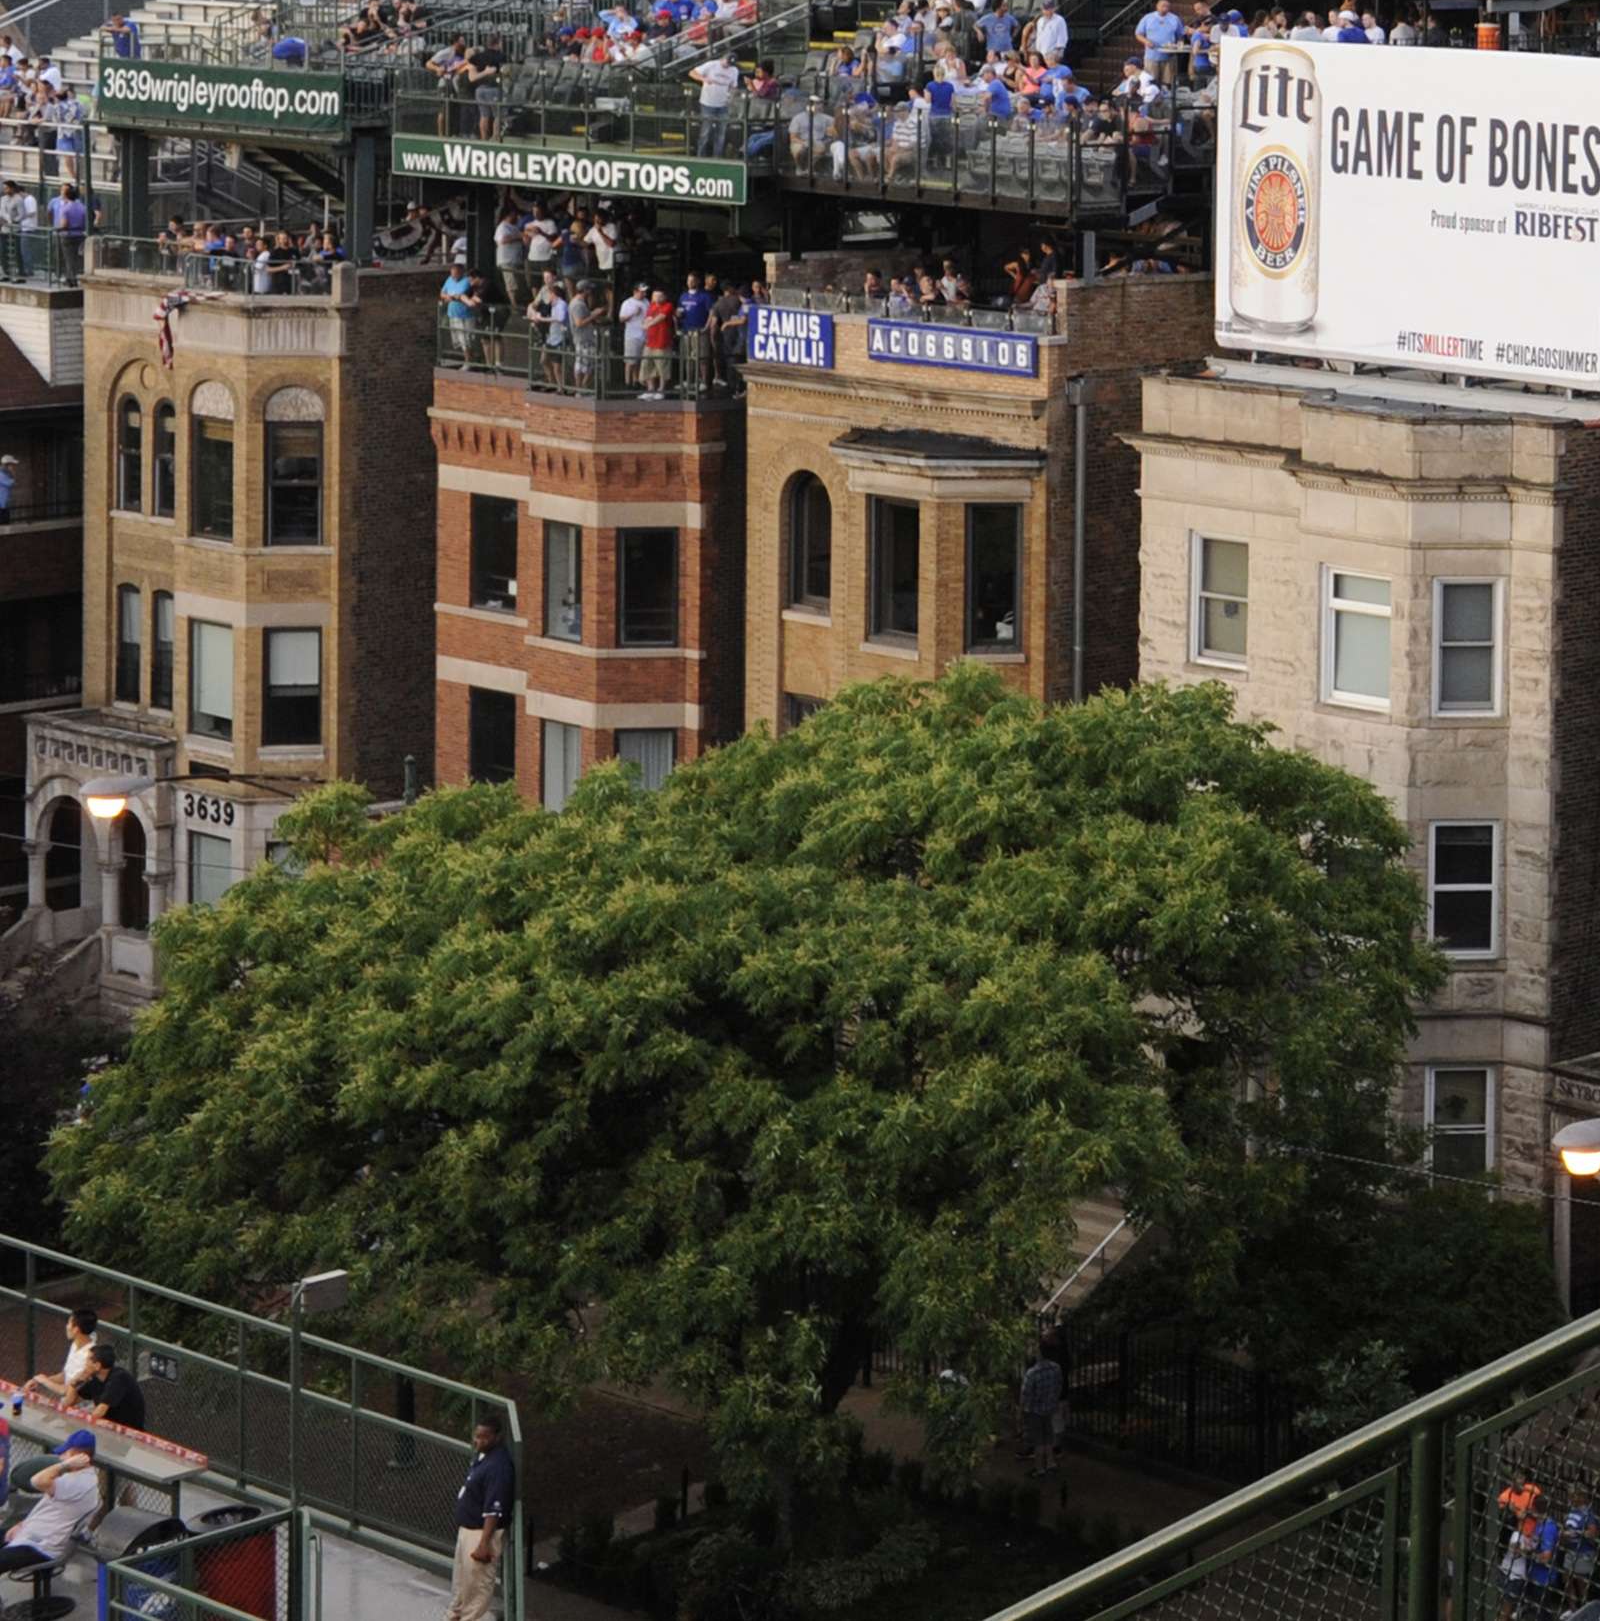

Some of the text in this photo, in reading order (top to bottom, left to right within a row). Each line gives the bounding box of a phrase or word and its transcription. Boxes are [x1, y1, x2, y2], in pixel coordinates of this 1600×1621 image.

[102, 66, 341, 120] 3639wrigleyrooftop.com
[1239, 64, 1315, 134] Lite
[1331, 106, 1424, 180] GAME
[1436, 113, 1478, 185] OF
[1247, 161, 1269, 200] FINE
[1268, 157, 1306, 226] PILSNER
[1430, 209, 1507, 235] Proud sponsor of
[1514, 210, 1599, 243] RIBFEST
[1255, 243, 1295, 267] BEER
[757, 309, 821, 341] EAMUS
[753, 334, 825, 367] CATULI!
[1397, 330, 1599, 374] #ITSMILLERTIME #CHICAGOSUMMER
[184, 793, 235, 826] 3639
